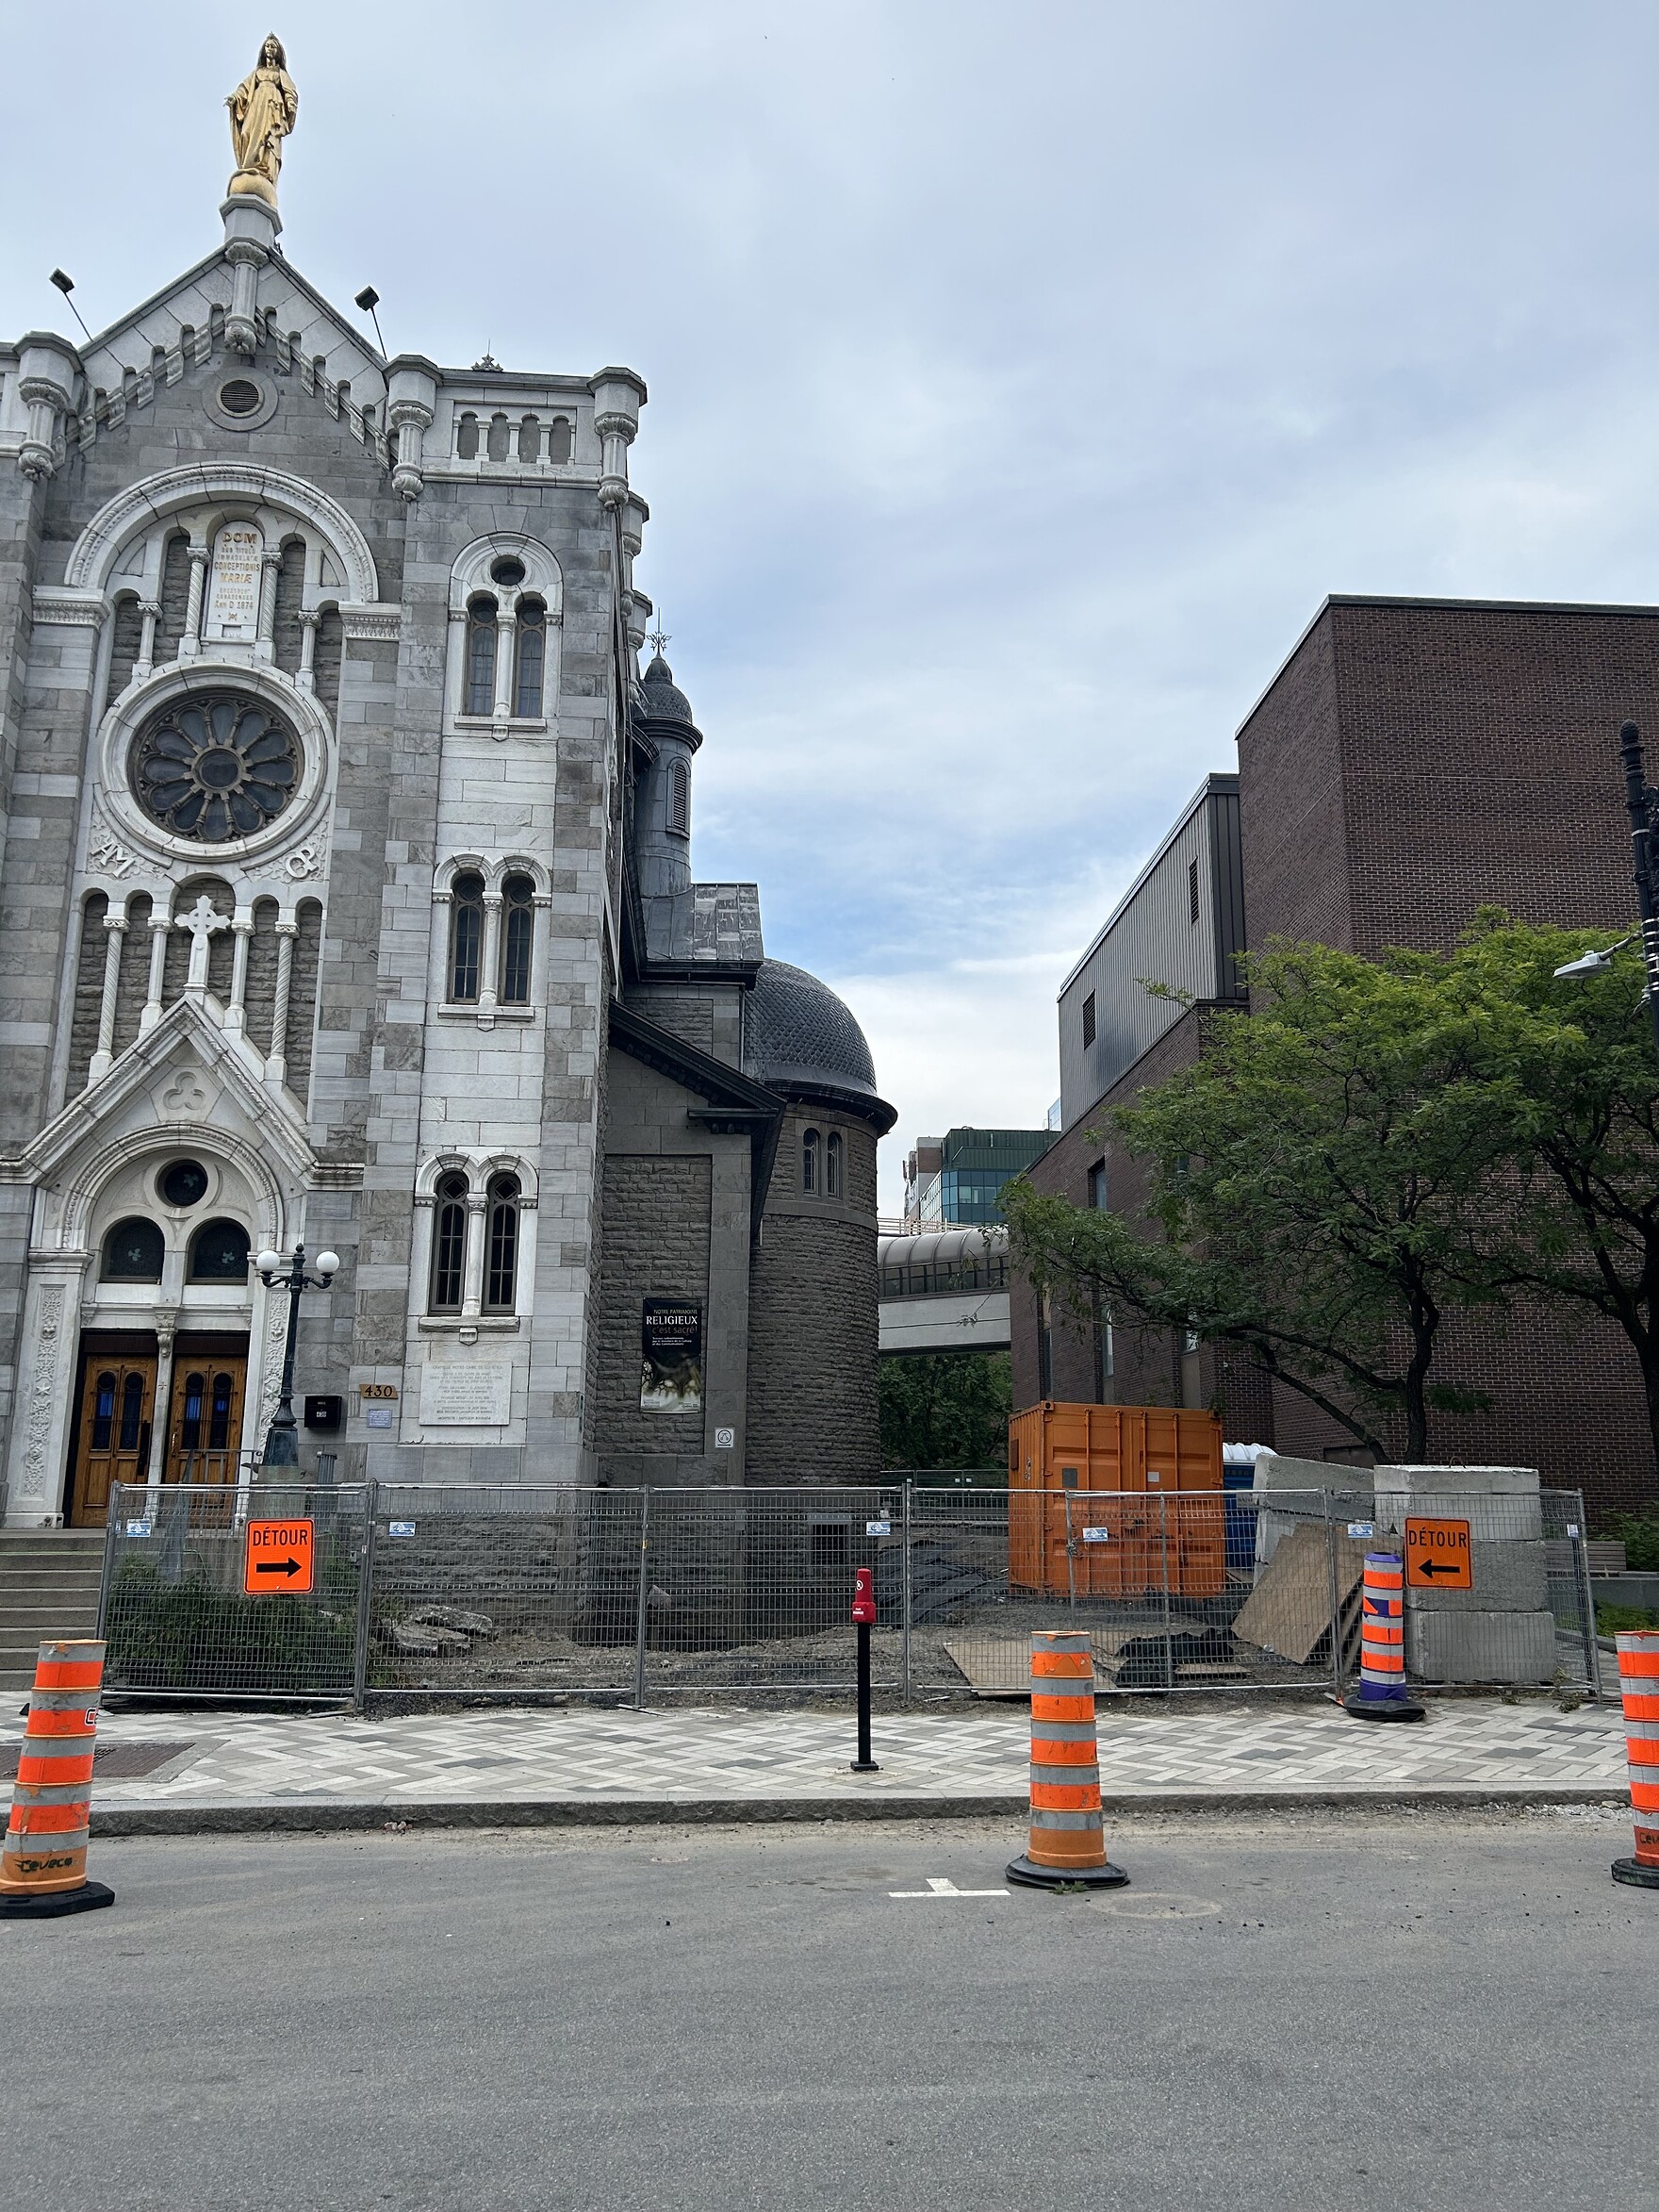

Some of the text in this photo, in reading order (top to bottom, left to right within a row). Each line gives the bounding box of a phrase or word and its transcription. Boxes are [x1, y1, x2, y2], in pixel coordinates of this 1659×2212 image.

[222, 532, 257, 544] DOM
[214, 561, 261, 571] CONCEPTIONIS
[237, 601, 254, 610] 1874
[646, 1315, 698, 1325] RELIGIEUX
[651, 1326, 671, 1334] c'est
[365, 1385, 393, 1397] 430
[253, 1526, 308, 1546] DÉTOUR
[1408, 1527, 1468, 1548] DÉTOUR
